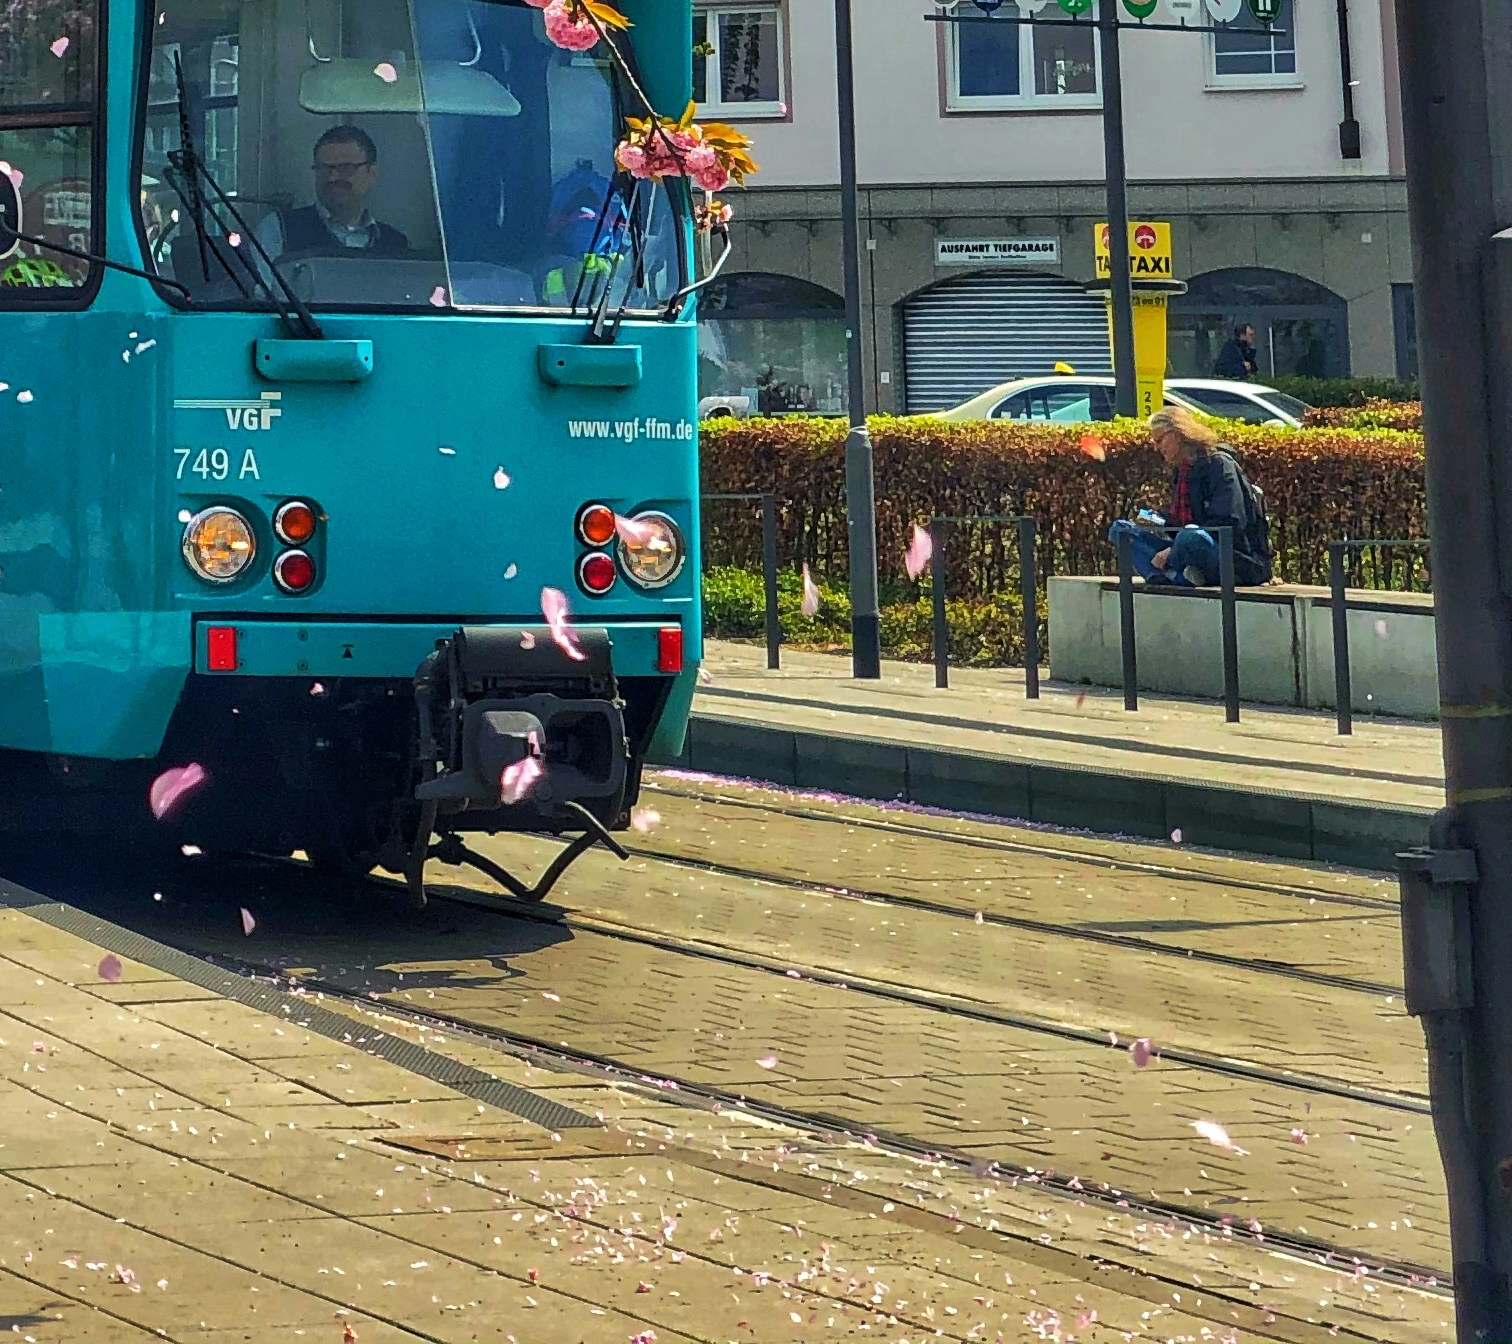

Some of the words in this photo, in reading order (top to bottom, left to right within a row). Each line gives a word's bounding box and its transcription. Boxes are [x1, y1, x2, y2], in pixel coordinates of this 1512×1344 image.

[940, 243, 990, 253] AUSFAHRT
[993, 243, 1054, 252] TIEFGARAGE
[1096, 256, 1112, 272] TA
[1129, 256, 1170, 273] TAXI
[225, 408, 282, 430] VGF
[568, 417, 693, 443] www.vgf-ffm.de
[173, 448, 229, 480] 749
[238, 448, 260, 480] A
